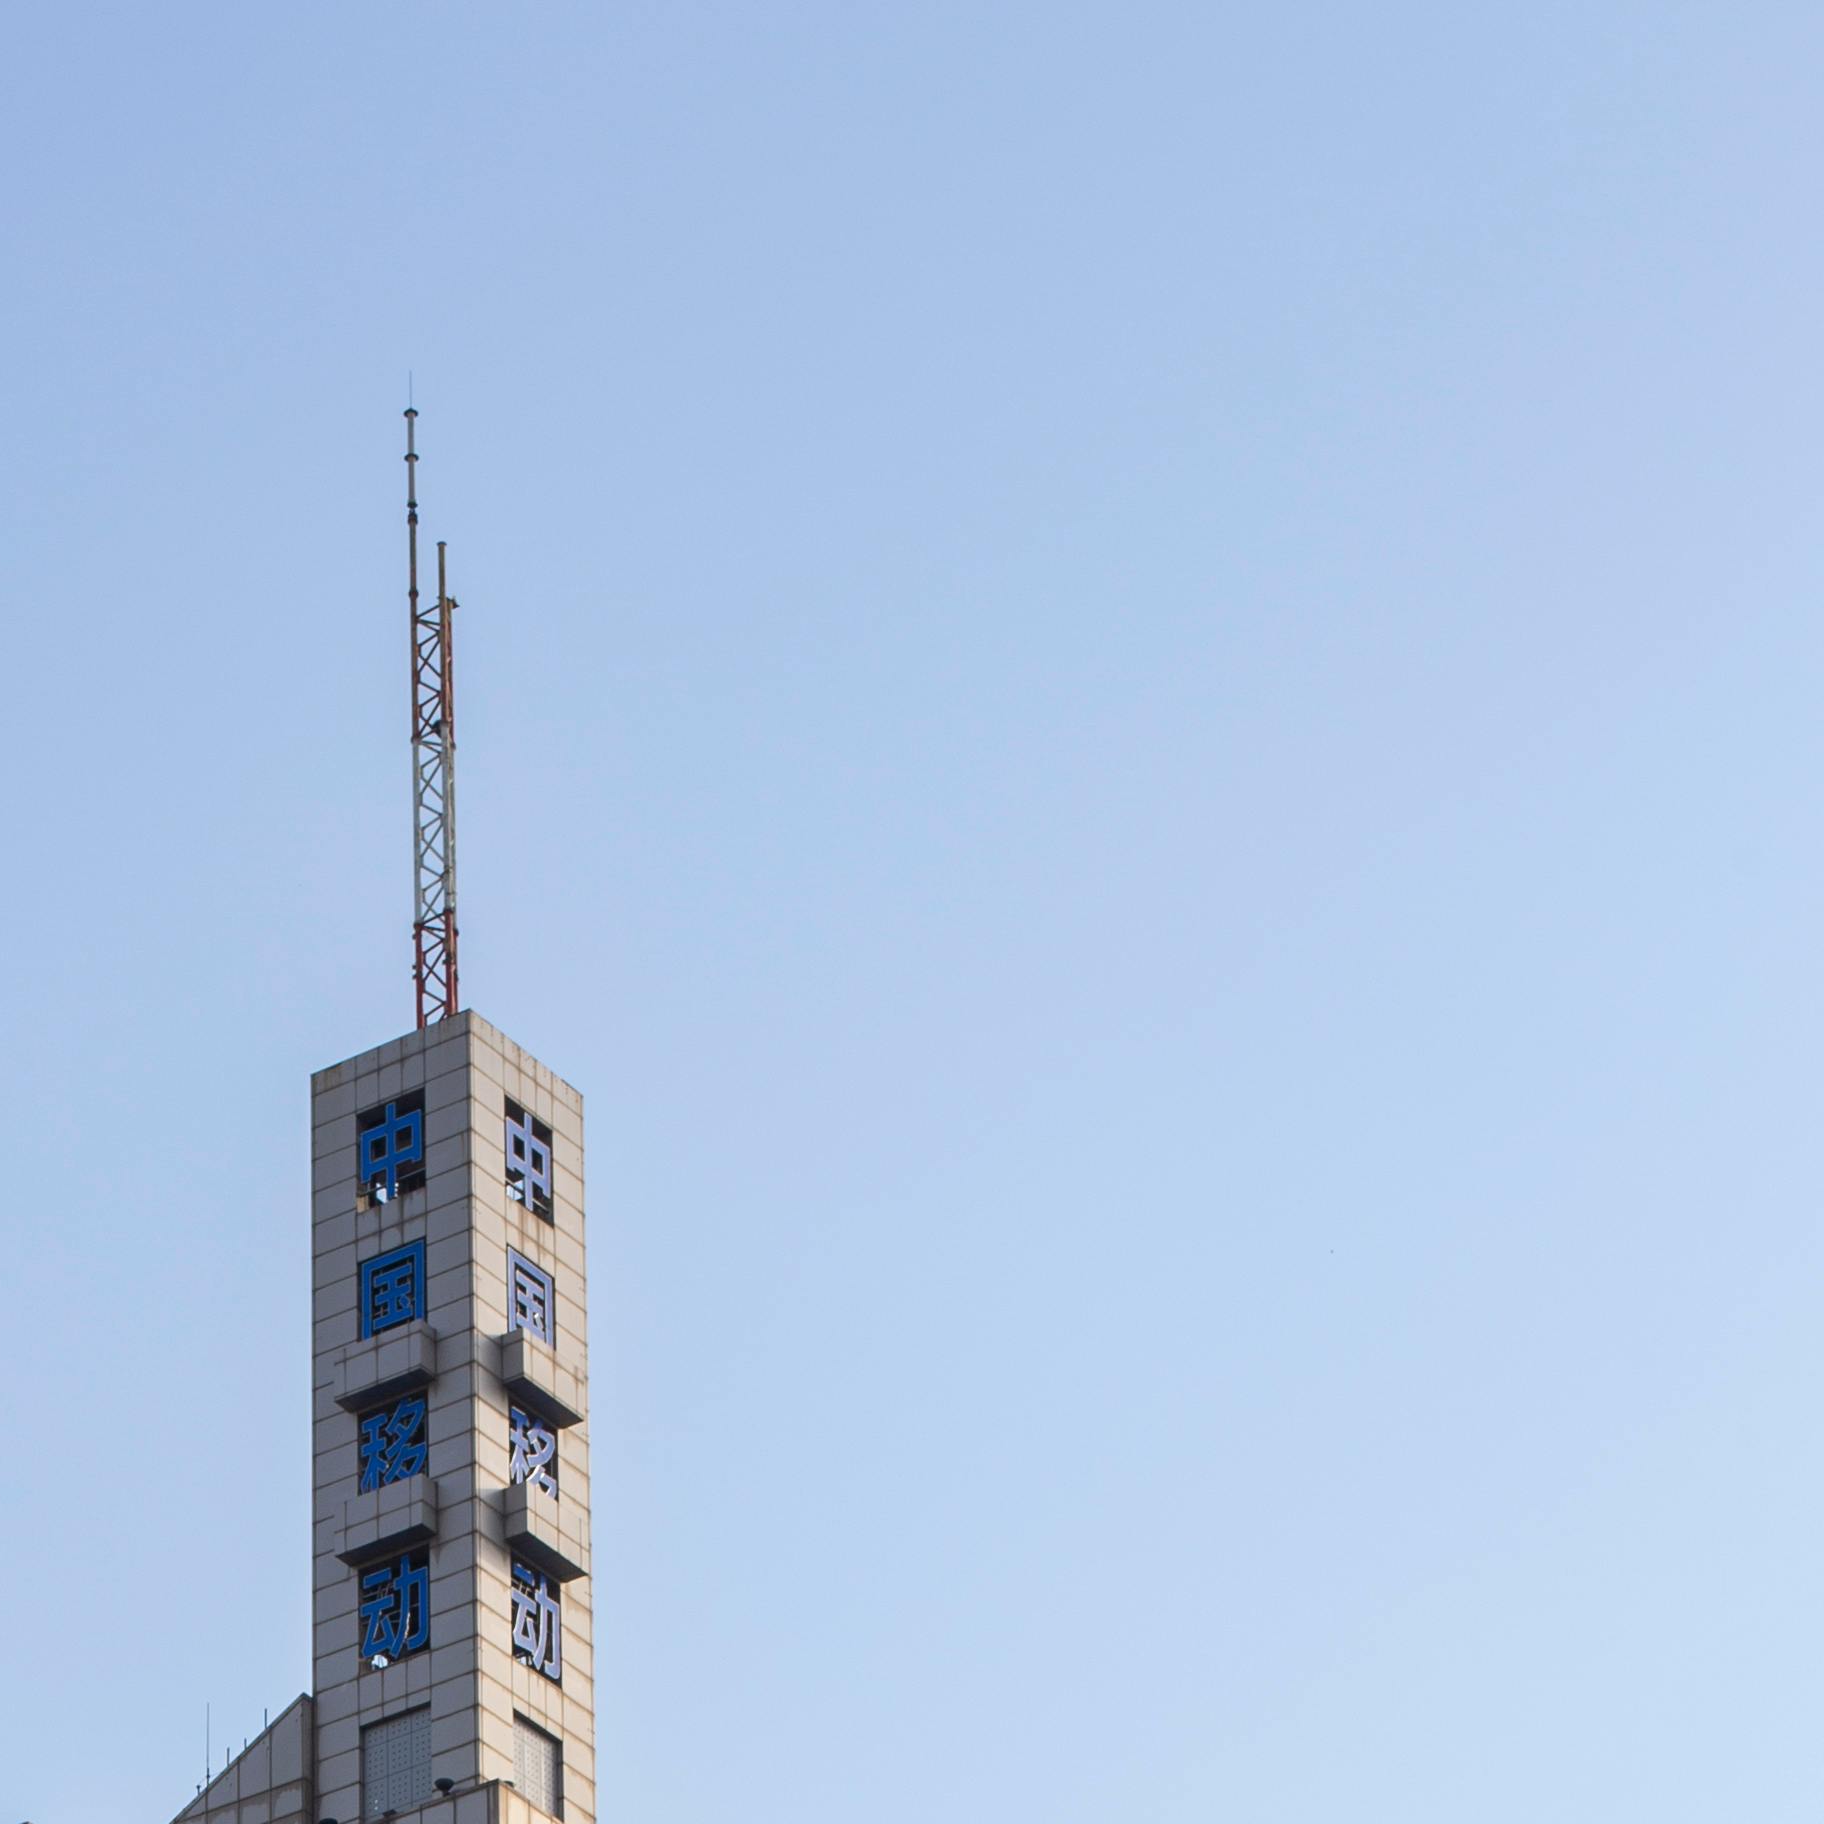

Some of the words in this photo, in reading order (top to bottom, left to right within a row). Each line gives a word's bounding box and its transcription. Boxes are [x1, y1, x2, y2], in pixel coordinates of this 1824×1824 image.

[360, 1102, 430, 1658] 中国移动
[506, 1111, 562, 1680] 中国移动
